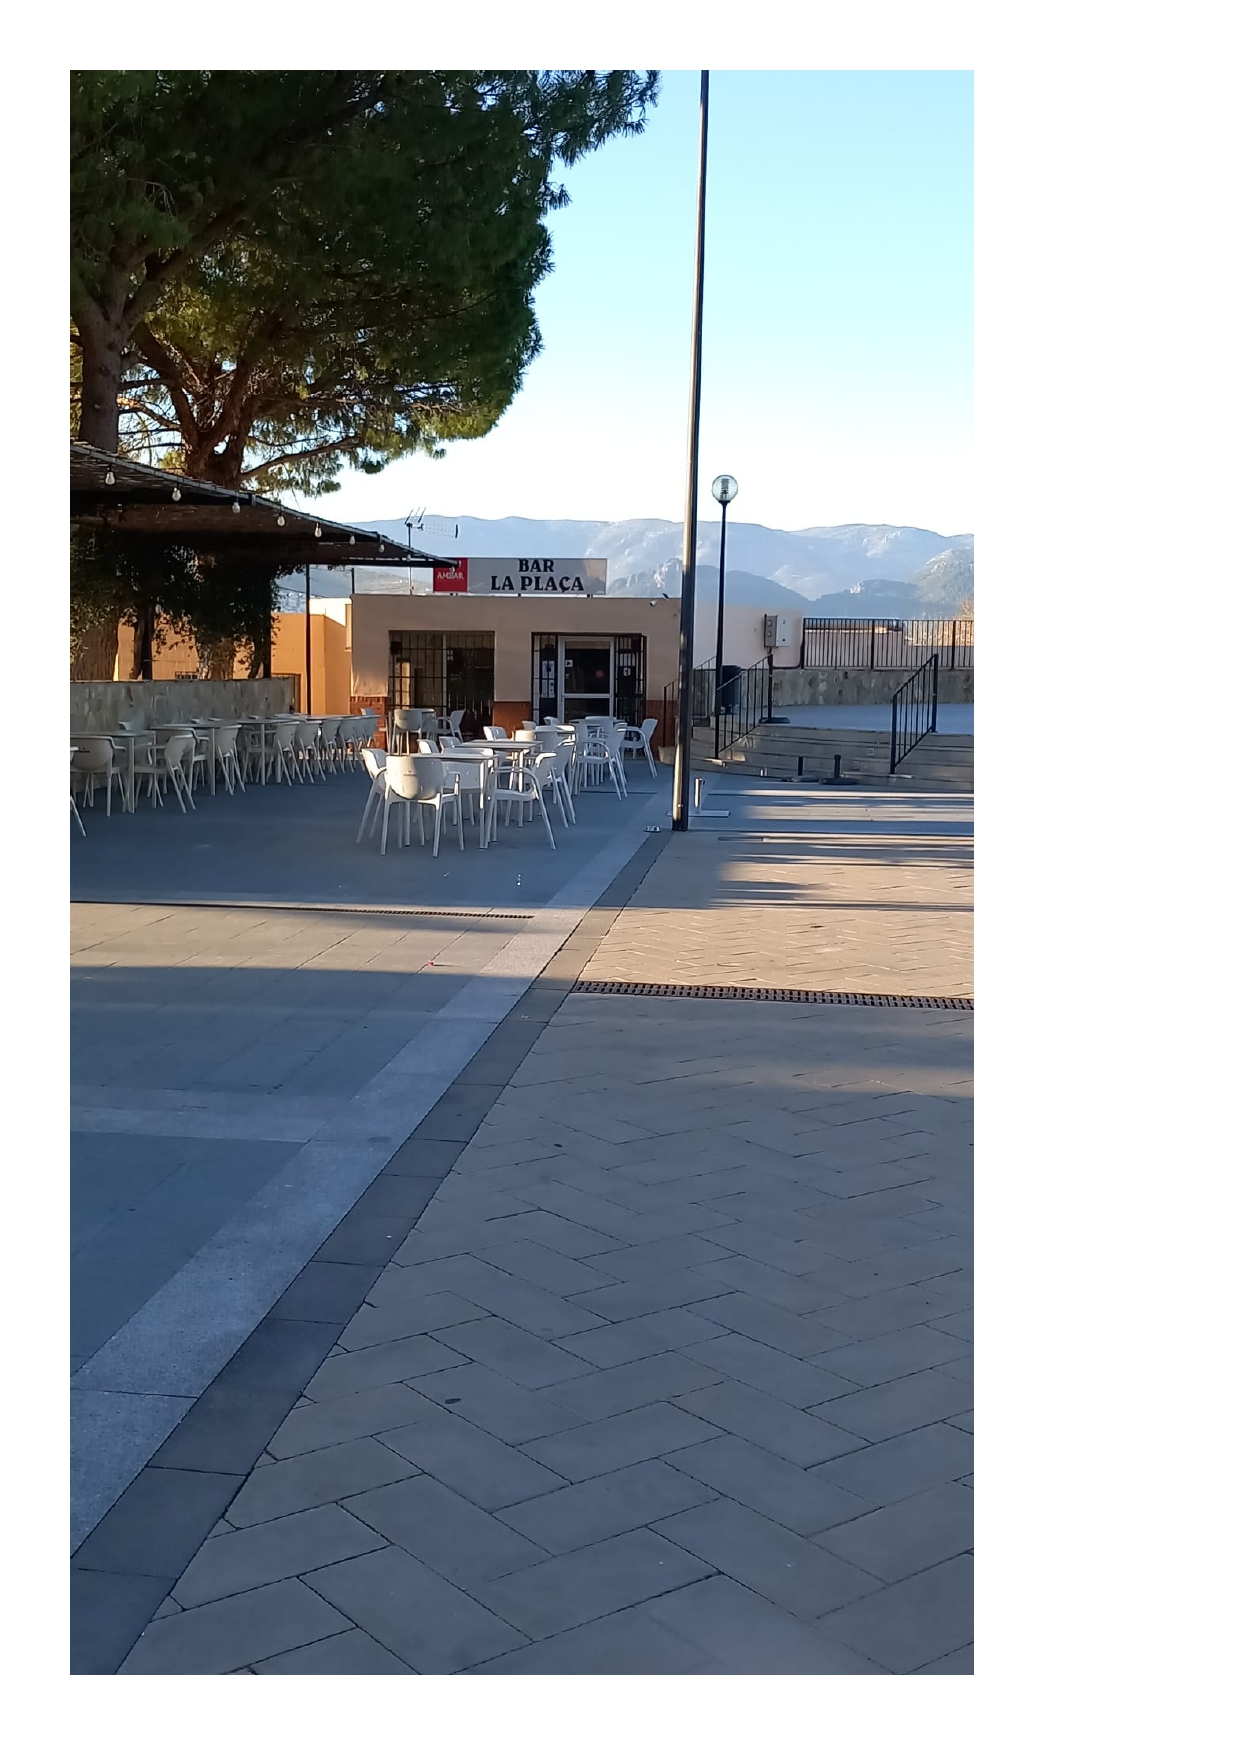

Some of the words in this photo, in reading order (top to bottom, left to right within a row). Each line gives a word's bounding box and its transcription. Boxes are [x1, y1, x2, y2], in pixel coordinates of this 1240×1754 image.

[518, 559, 555, 573] BAR
[490, 575, 515, 591] LA
[520, 575, 585, 593] PLAÇA
